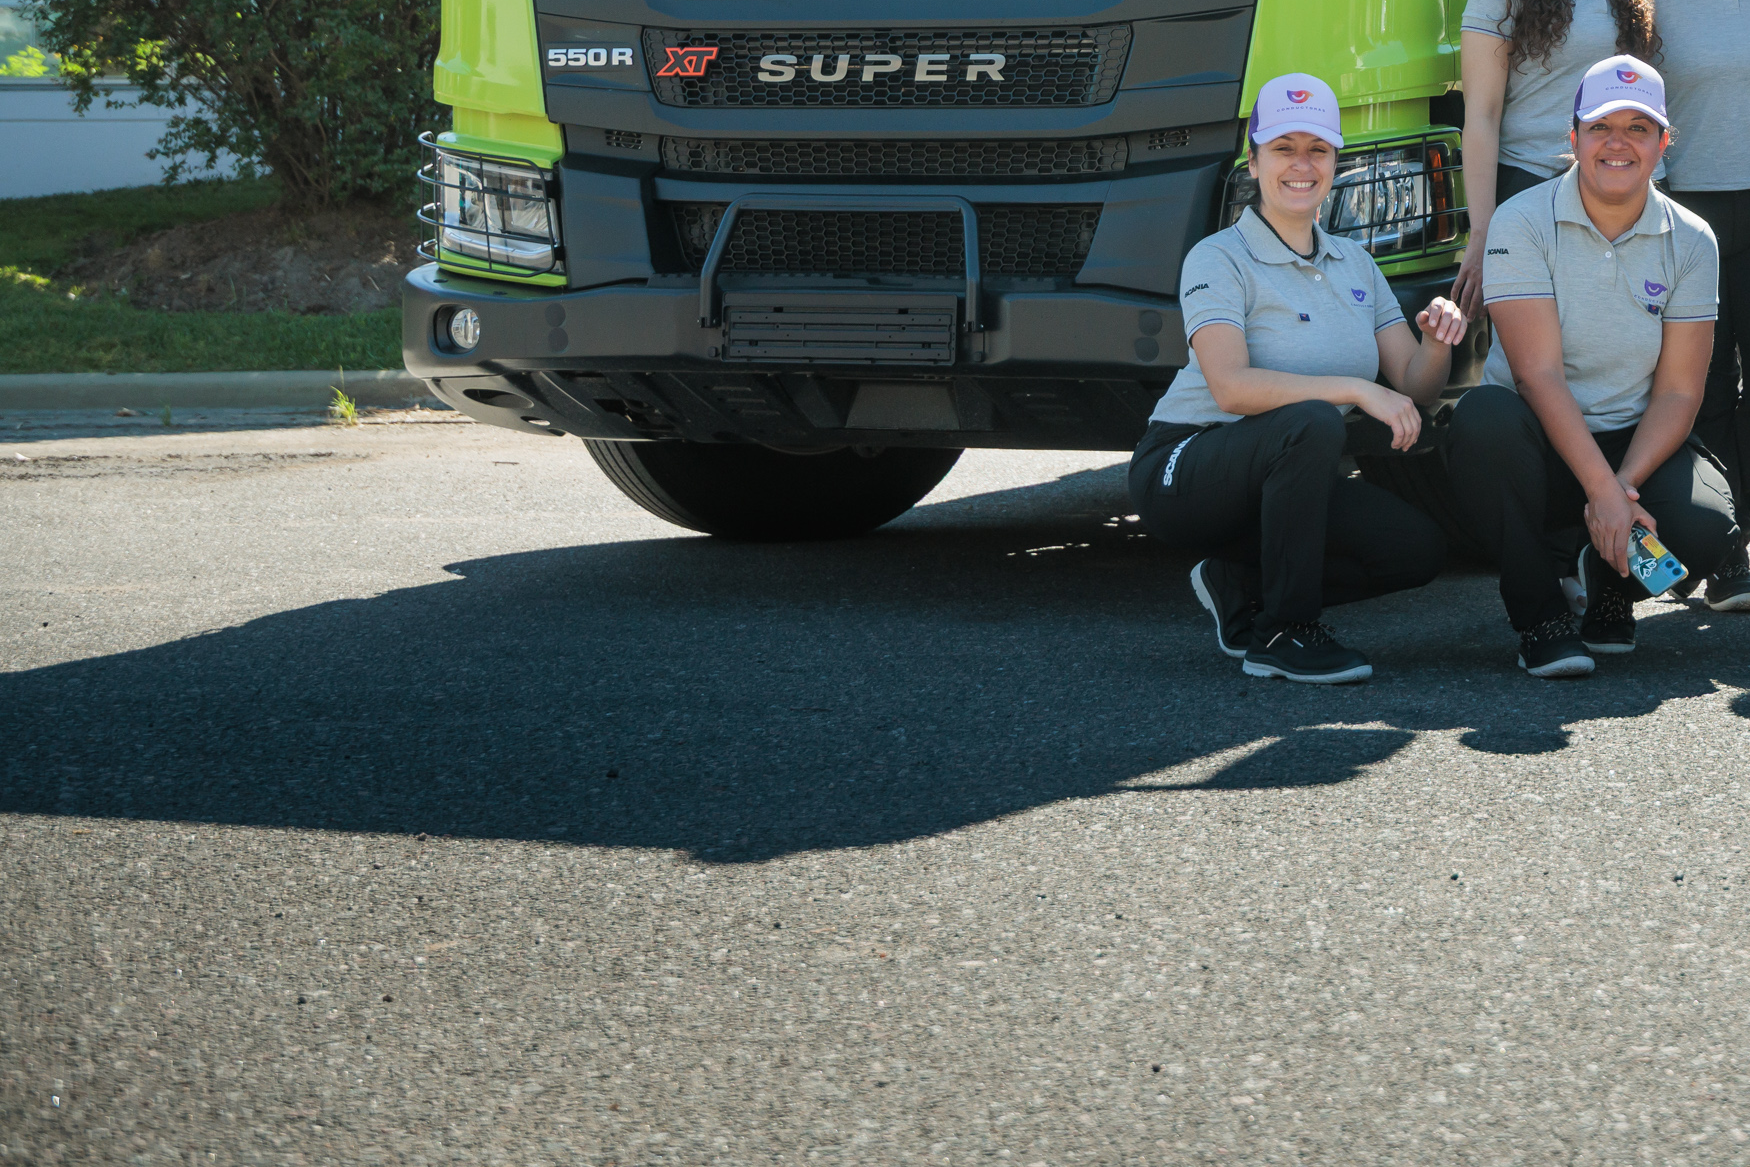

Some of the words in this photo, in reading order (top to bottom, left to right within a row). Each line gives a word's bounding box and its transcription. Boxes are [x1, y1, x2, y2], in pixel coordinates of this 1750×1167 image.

[548, 48, 602, 67] 550
[611, 48, 634, 66] R
[656, 47, 719, 77] XT
[758, 53, 1008, 82] SUPER
[1605, 86, 1653, 96] CONDUCTORAS
[1487, 248, 1510, 256] SCANIA
[1184, 283, 1210, 298] SCANIA
